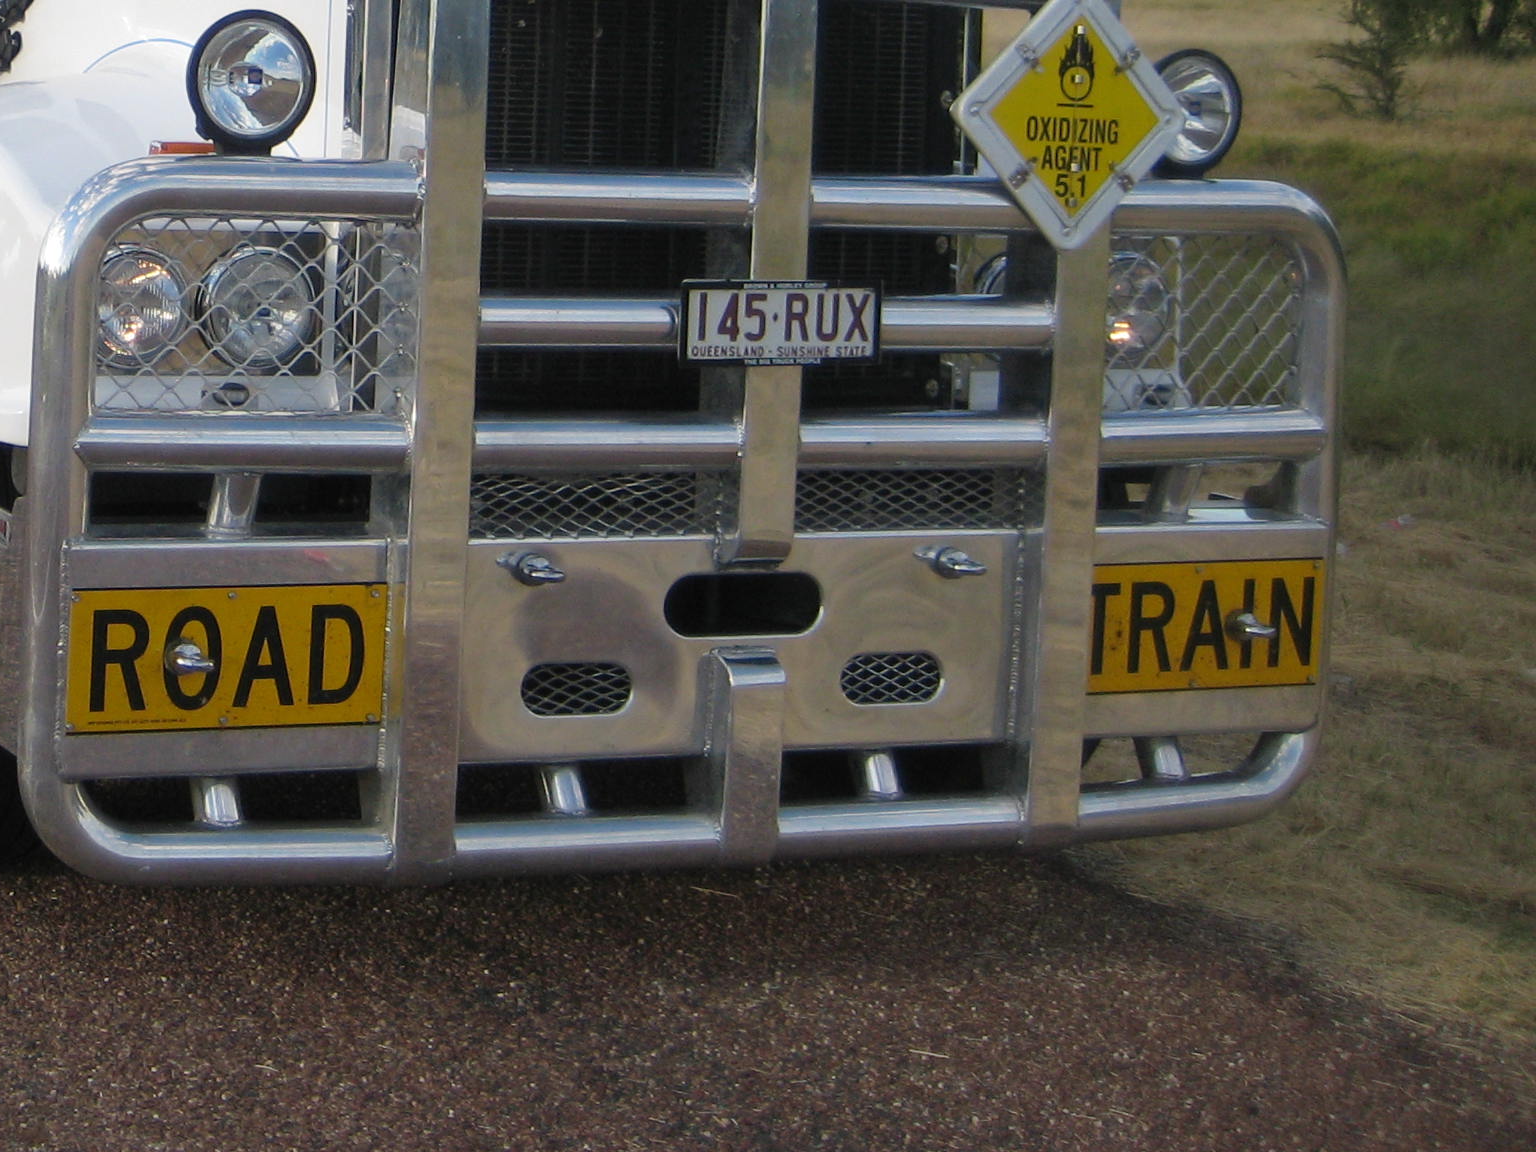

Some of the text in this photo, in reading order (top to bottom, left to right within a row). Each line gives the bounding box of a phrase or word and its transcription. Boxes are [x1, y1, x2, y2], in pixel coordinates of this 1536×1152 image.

[1026, 116, 1119, 144] OXIDIZING
[1041, 145, 1102, 171] AGENT
[1054, 173, 1086, 198] 5.1
[691, 346, 764, 358] QUEENSLAND
[777, 345, 829, 358] SUNSHINE
[836, 345, 867, 358] STATE
[1091, 576, 1315, 675] TRAIN
[89, 603, 365, 713] ROAD
